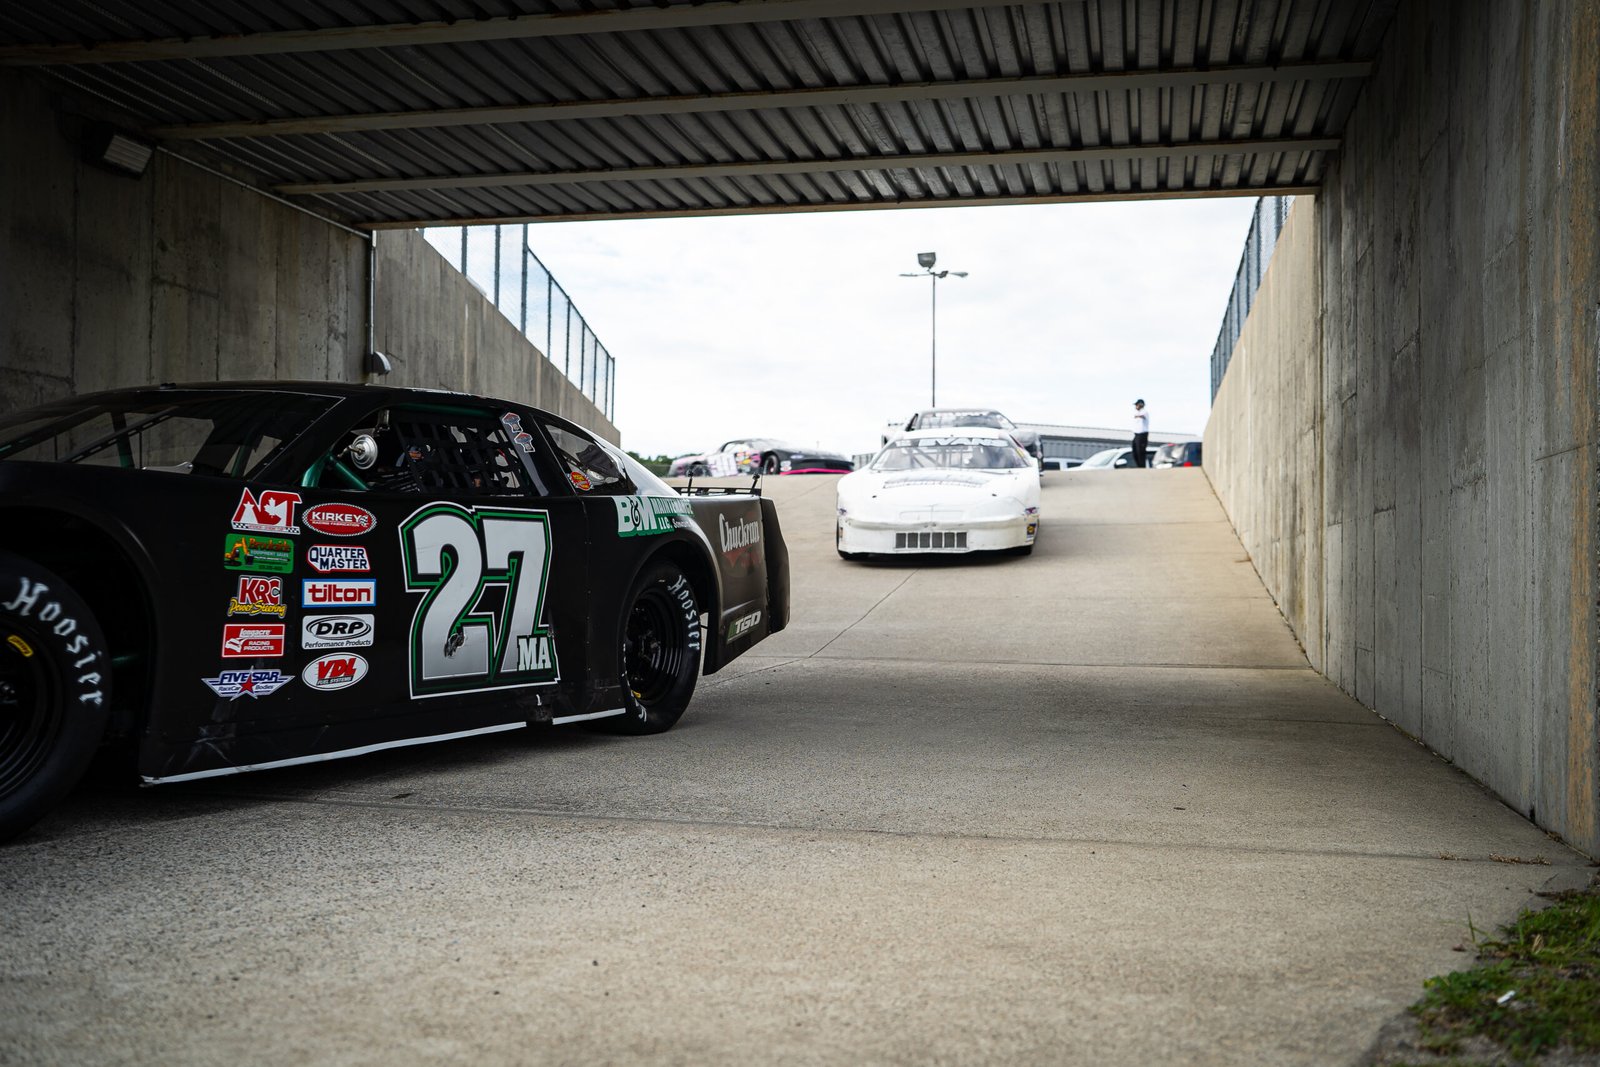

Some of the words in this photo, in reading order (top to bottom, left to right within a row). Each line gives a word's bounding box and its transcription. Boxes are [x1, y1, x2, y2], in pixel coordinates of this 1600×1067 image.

[918, 436, 1009, 447] EVANS
[233, 488, 303, 528] ACT
[312, 511, 362, 522] KIRKEY
[611, 496, 658, 532] B&M
[718, 513, 760, 553] Chuckran
[310, 547, 365, 563] QUARTER
[320, 558, 368, 570] MASTER
[240, 577, 281, 604] KRC
[308, 584, 371, 603] tilton
[412, 513, 548, 681] 27
[228, 598, 253, 616] Power
[250, 600, 286, 618] Steering
[667, 574, 701, 650] Hoosier
[315, 621, 364, 636] DRP
[1, 576, 104, 706] Hoosier
[304, 641, 345, 649] Performance
[345, 639, 371, 647] Products
[518, 636, 552, 671] MA
[220, 672, 248, 685] FIVE
[252, 671, 280, 683] STAR
[318, 658, 357, 680] VDL
